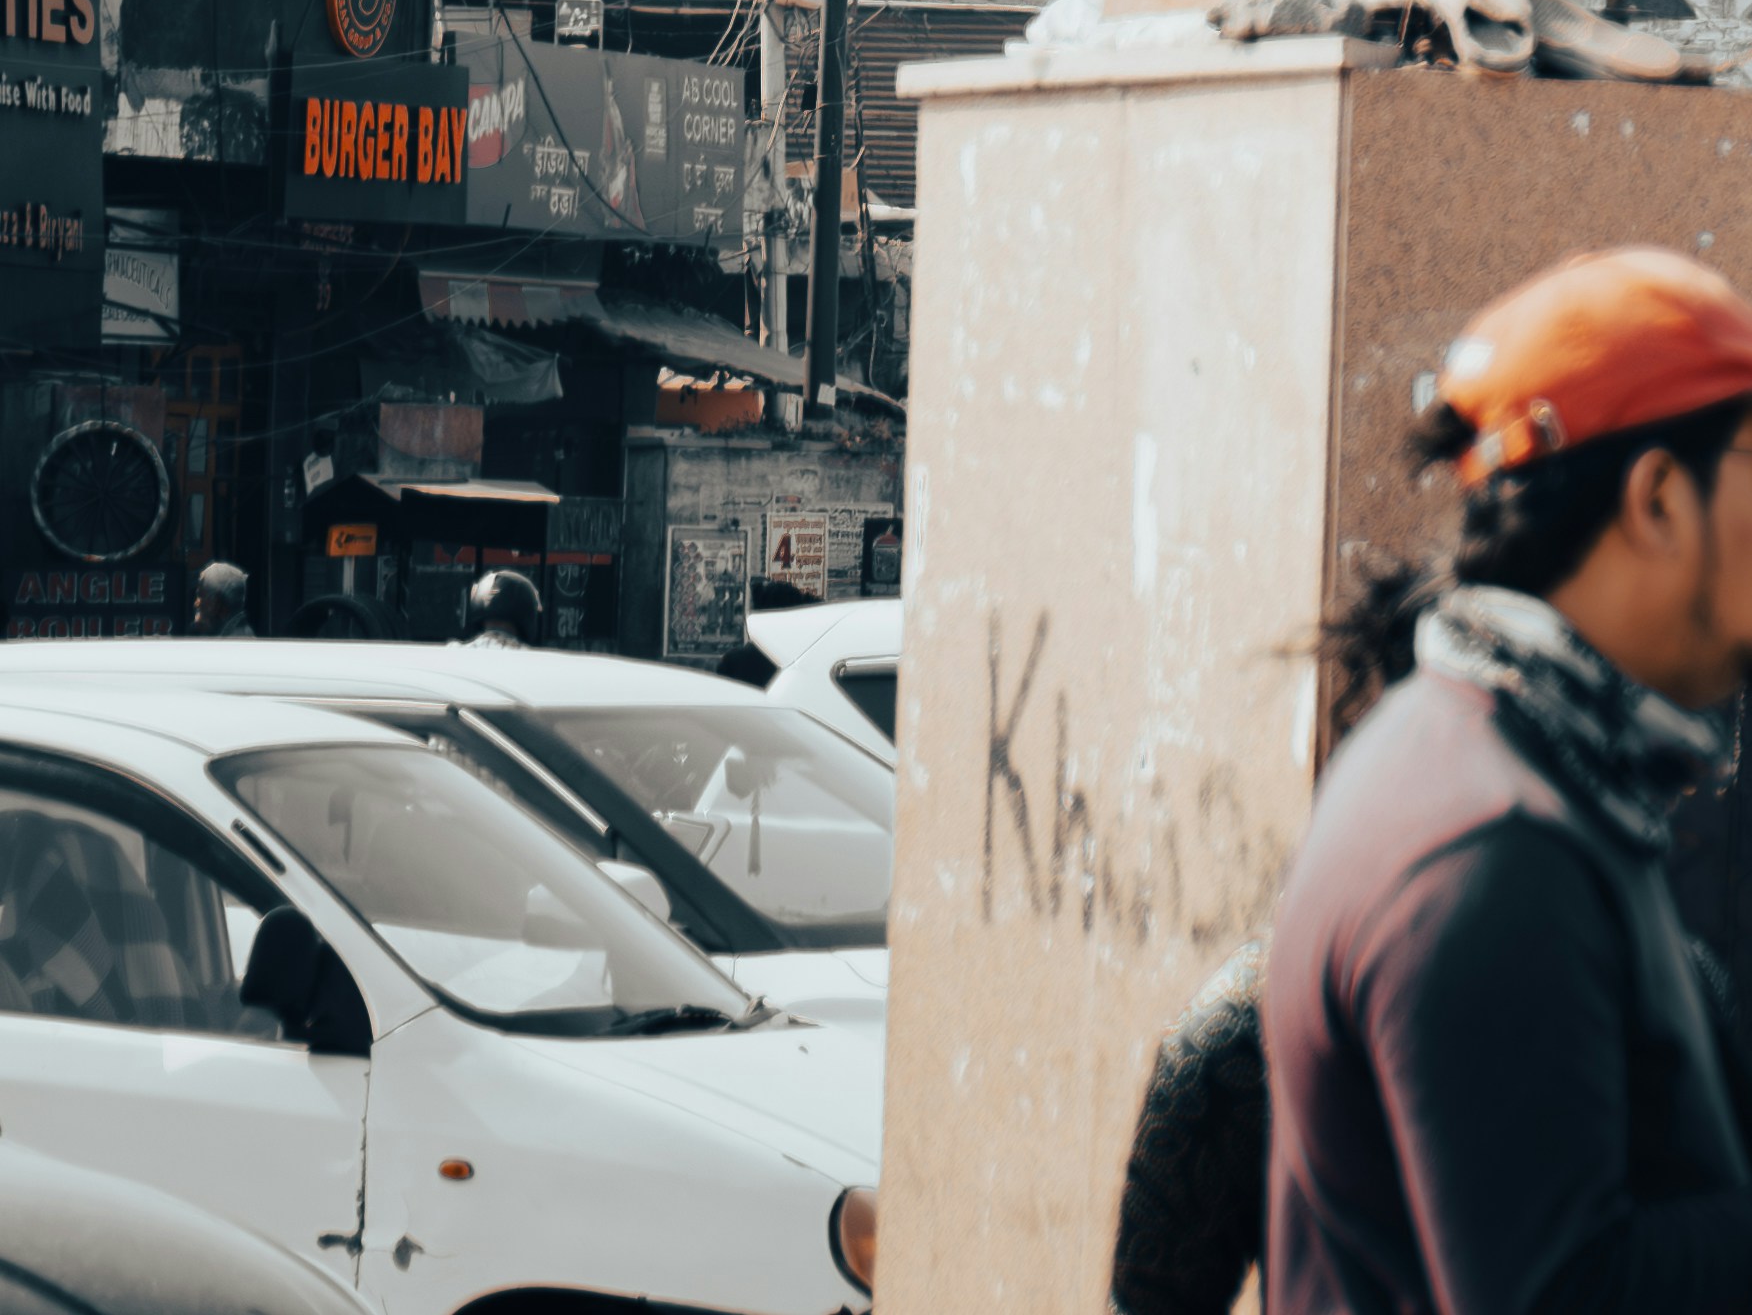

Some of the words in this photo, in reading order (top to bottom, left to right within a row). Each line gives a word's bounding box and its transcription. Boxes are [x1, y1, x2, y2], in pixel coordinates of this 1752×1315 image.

[25, 75, 56, 112] With
[61, 85, 92, 117] Food
[468, 76, 525, 144] CAMPA
[703, 78, 738, 109] COOL
[303, 97, 409, 183] BURGER
[417, 105, 468, 185] BAY
[684, 113, 736, 146] CORNER
[16, 571, 165, 604] ANGLE
